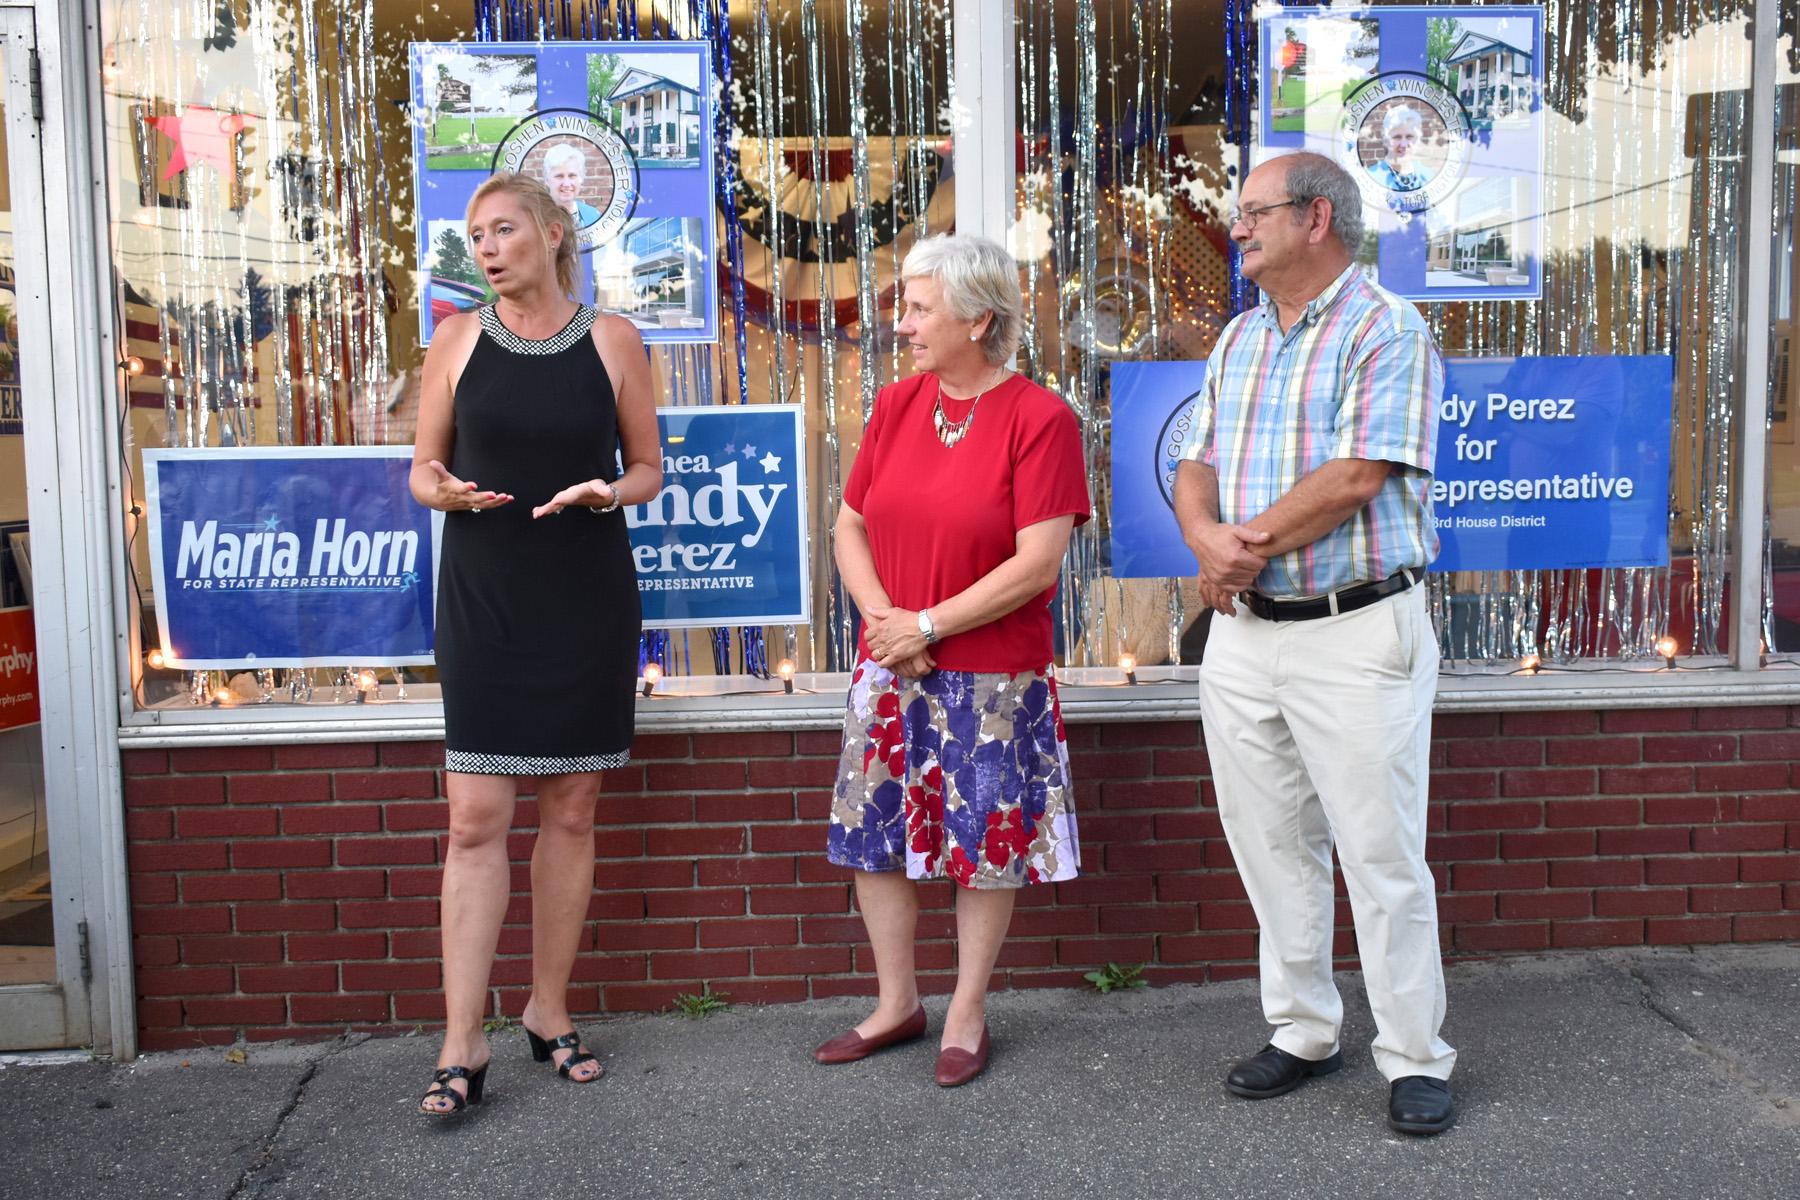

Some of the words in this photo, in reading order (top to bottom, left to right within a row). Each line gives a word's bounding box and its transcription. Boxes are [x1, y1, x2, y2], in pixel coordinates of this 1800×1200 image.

[558, 116, 630, 191] WINCHESTER
[1487, 393, 1575, 420] Perez
[660, 446, 712, 474] hea
[1455, 433, 1498, 461] for
[1433, 472, 1634, 508] epresentative
[1434, 517, 1452, 529] 3rd
[1456, 516, 1498, 528] House
[1501, 515, 1546, 528] District
[175, 520, 301, 579] Maria
[308, 518, 420, 577] Horn
[631, 543, 736, 574] erez
[183, 579, 213, 590] FOR
[219, 578, 265, 589] STATE
[270, 576, 402, 588] REPRESENTATIVE
[637, 575, 755, 592] EPRESENTATIVE
[0, 646, 34, 678] rphy
